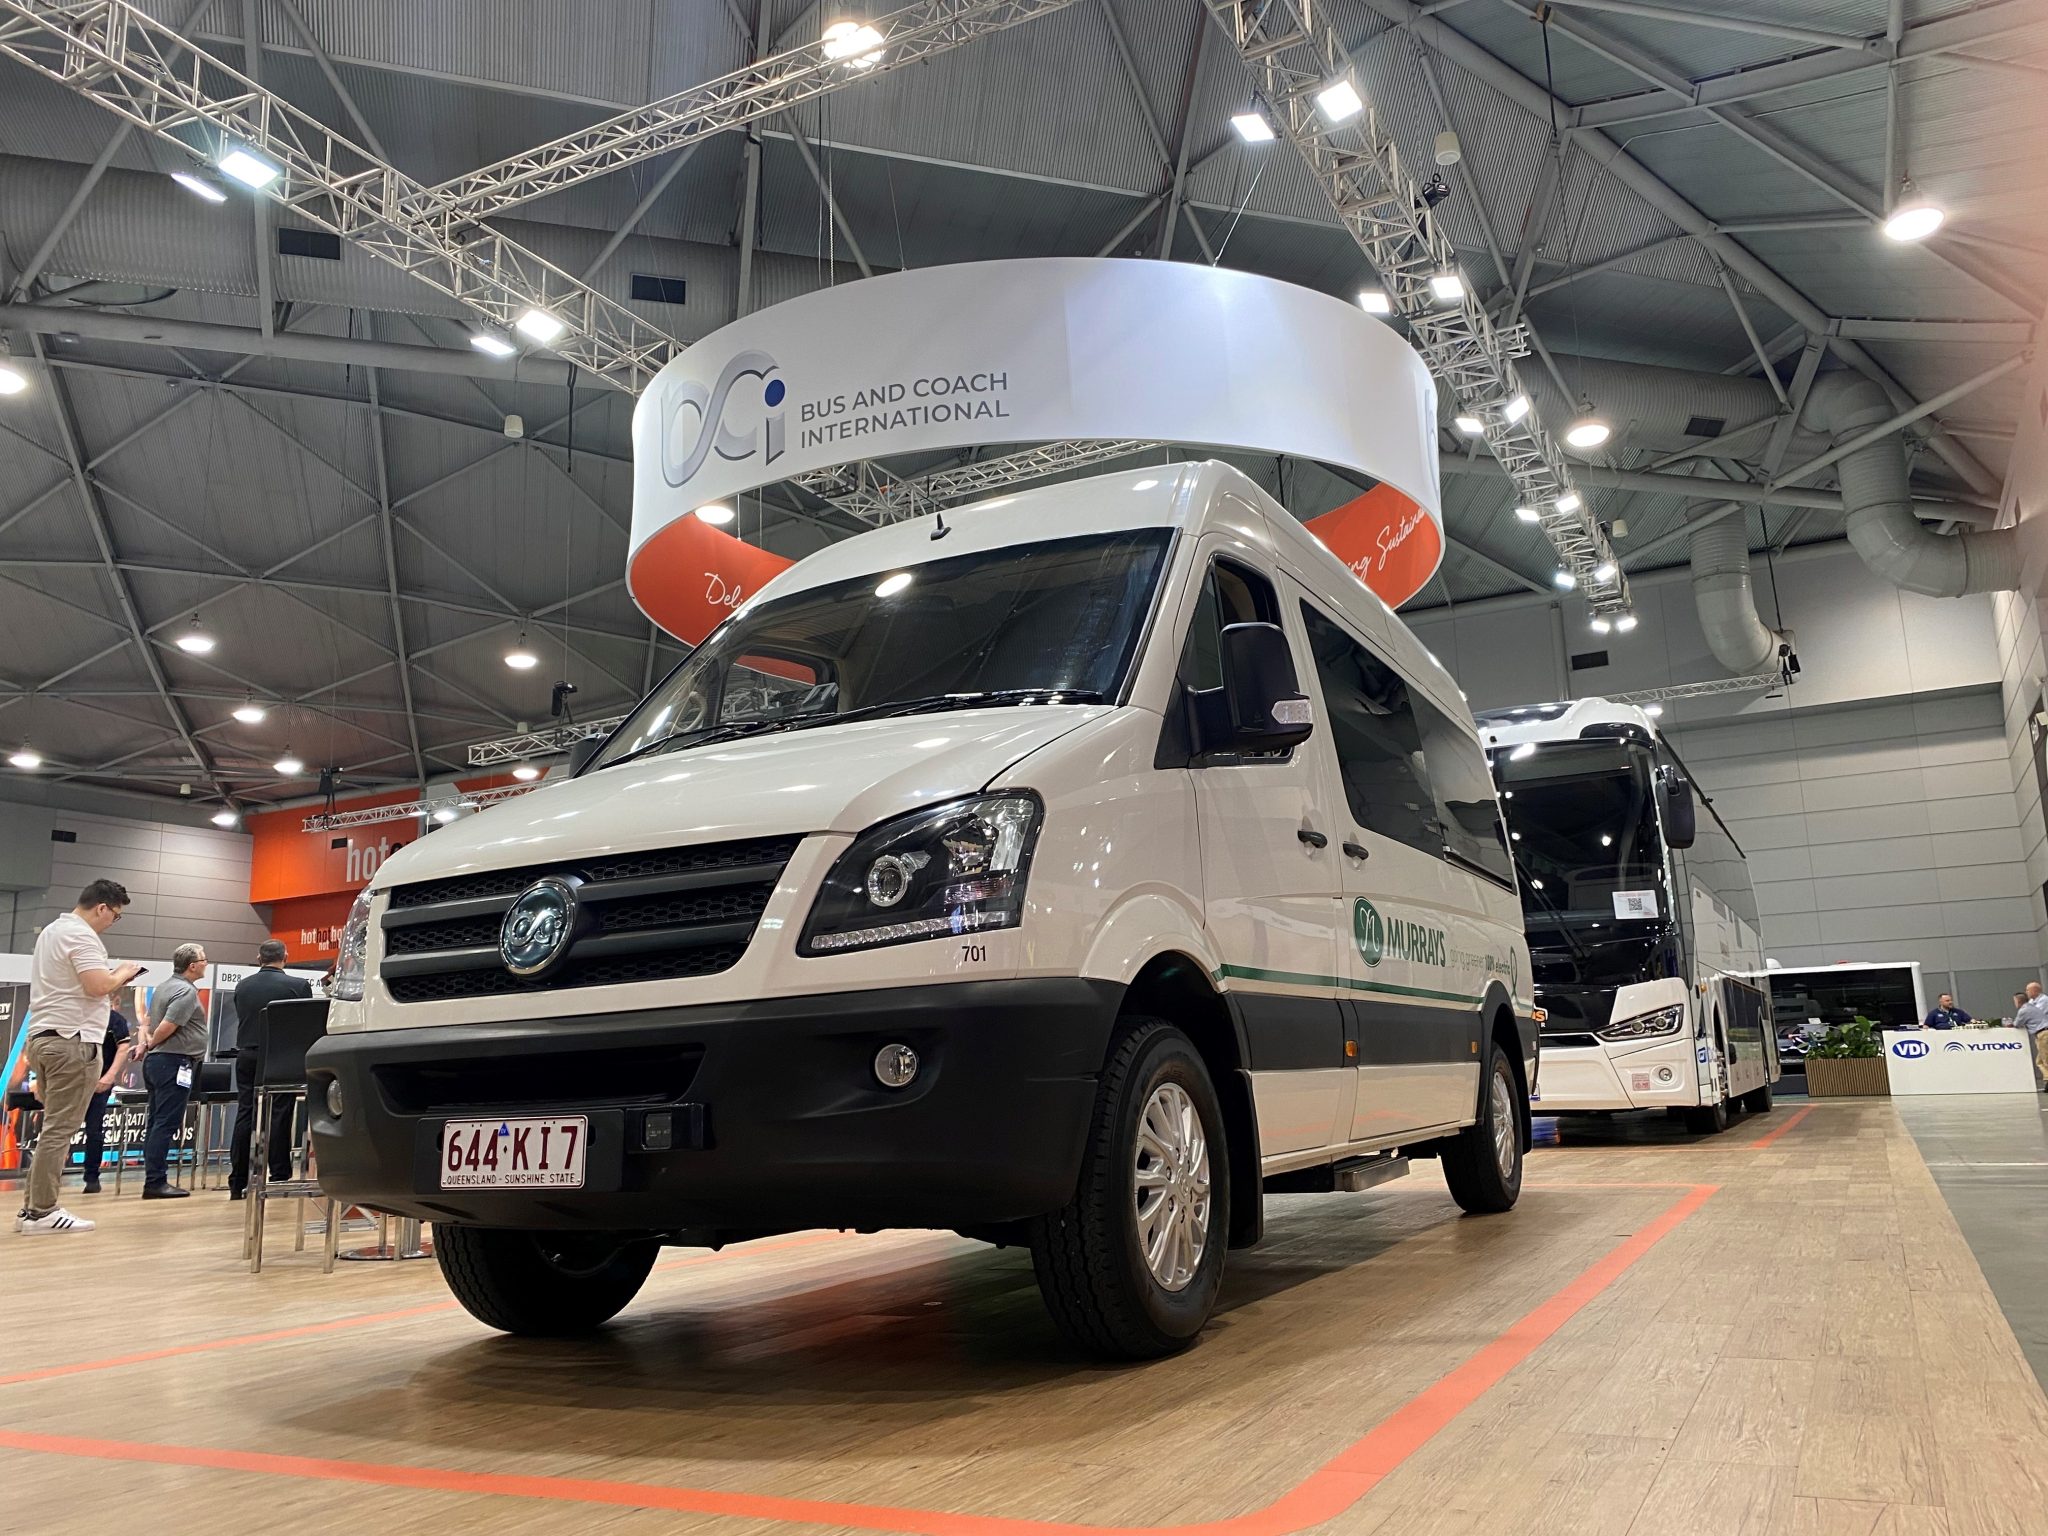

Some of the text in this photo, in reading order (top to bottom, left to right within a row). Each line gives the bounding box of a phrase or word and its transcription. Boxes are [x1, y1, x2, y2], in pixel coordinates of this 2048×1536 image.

[801, 371, 1009, 423] BUS AND COACH
[801, 399, 1010, 449] INTERNATIONAL
[704, 572, 743, 609] Deli
[962, 945, 987, 962] 701
[1387, 916, 1446, 968] MURRAYS
[1897, 1041, 1928, 1056] VDI
[1967, 1041, 2023, 1051] YUTONG
[447, 1172, 576, 1185] QUEENSLAND SUNSHINE STATE
